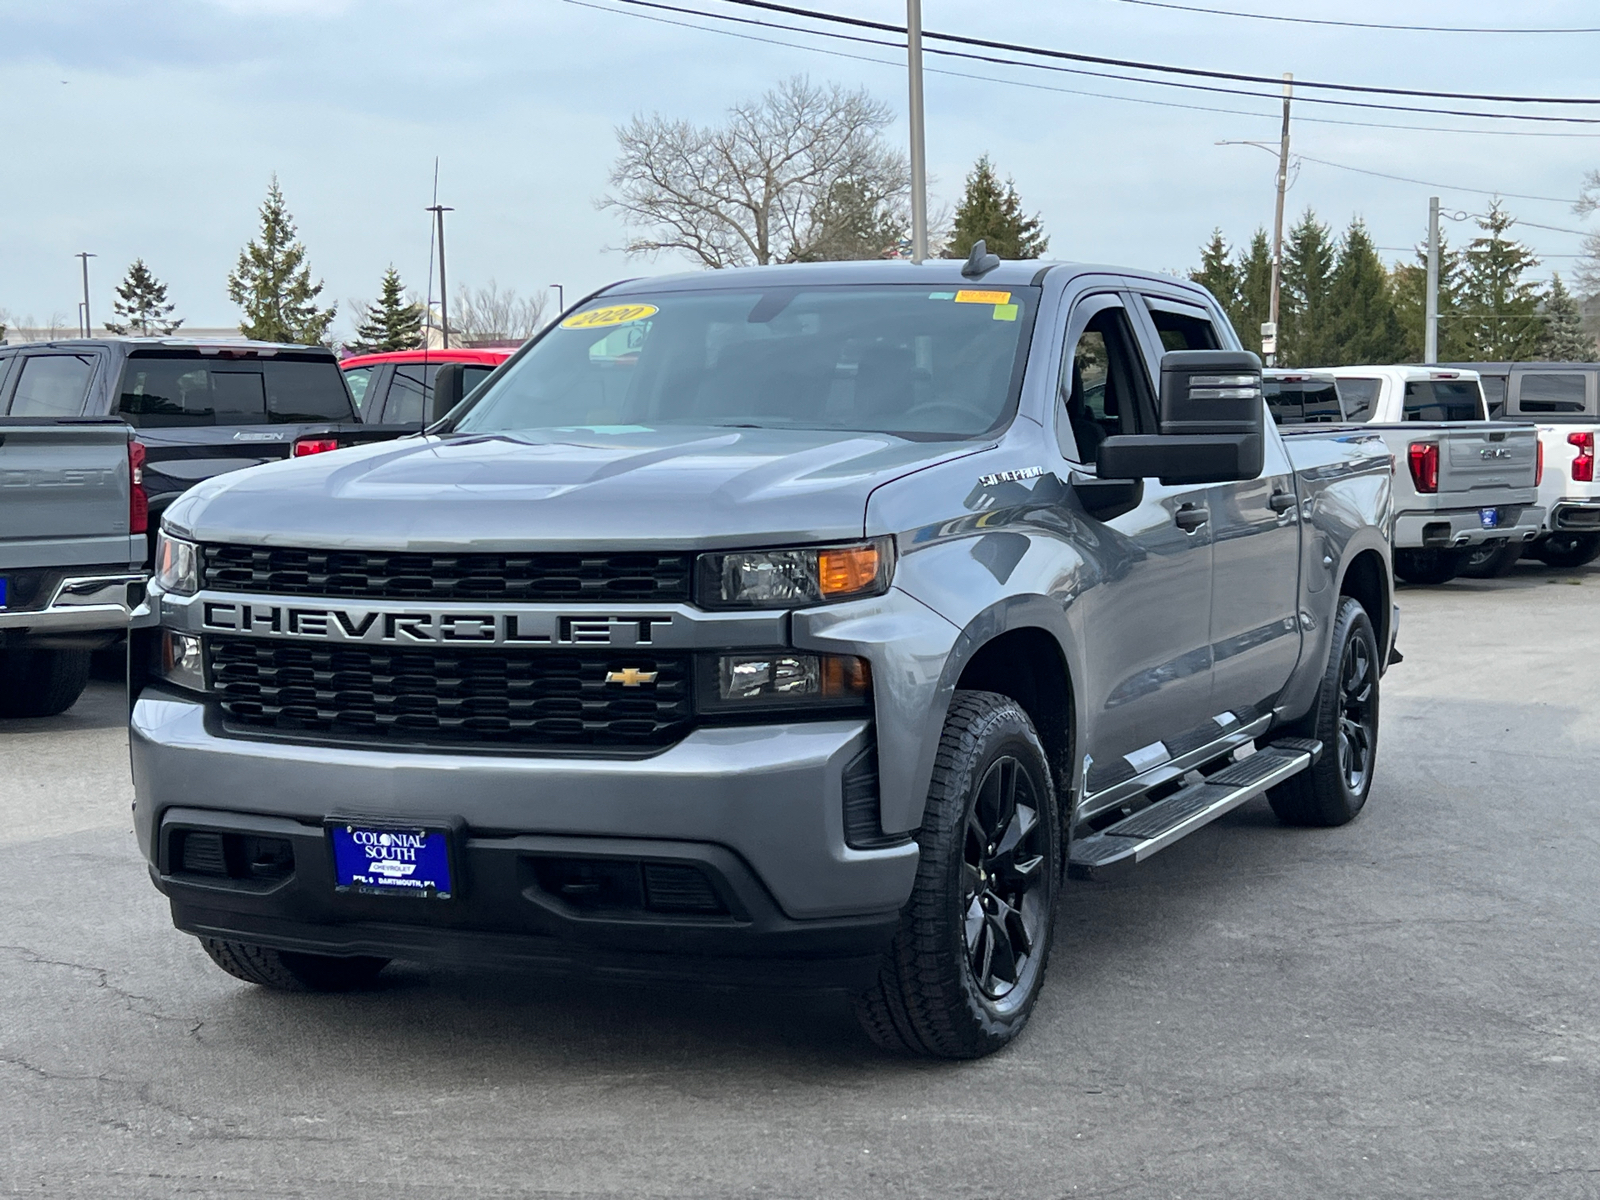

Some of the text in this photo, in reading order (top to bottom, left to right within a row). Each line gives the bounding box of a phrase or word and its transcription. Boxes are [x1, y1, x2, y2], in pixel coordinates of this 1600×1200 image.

[571, 307, 644, 326] 2020
[203, 602, 673, 643] CHEVROLET
[353, 831, 426, 848] COLONIAL
[365, 846, 416, 860] SOUTH
[373, 864, 411, 872] CHEVROLET
